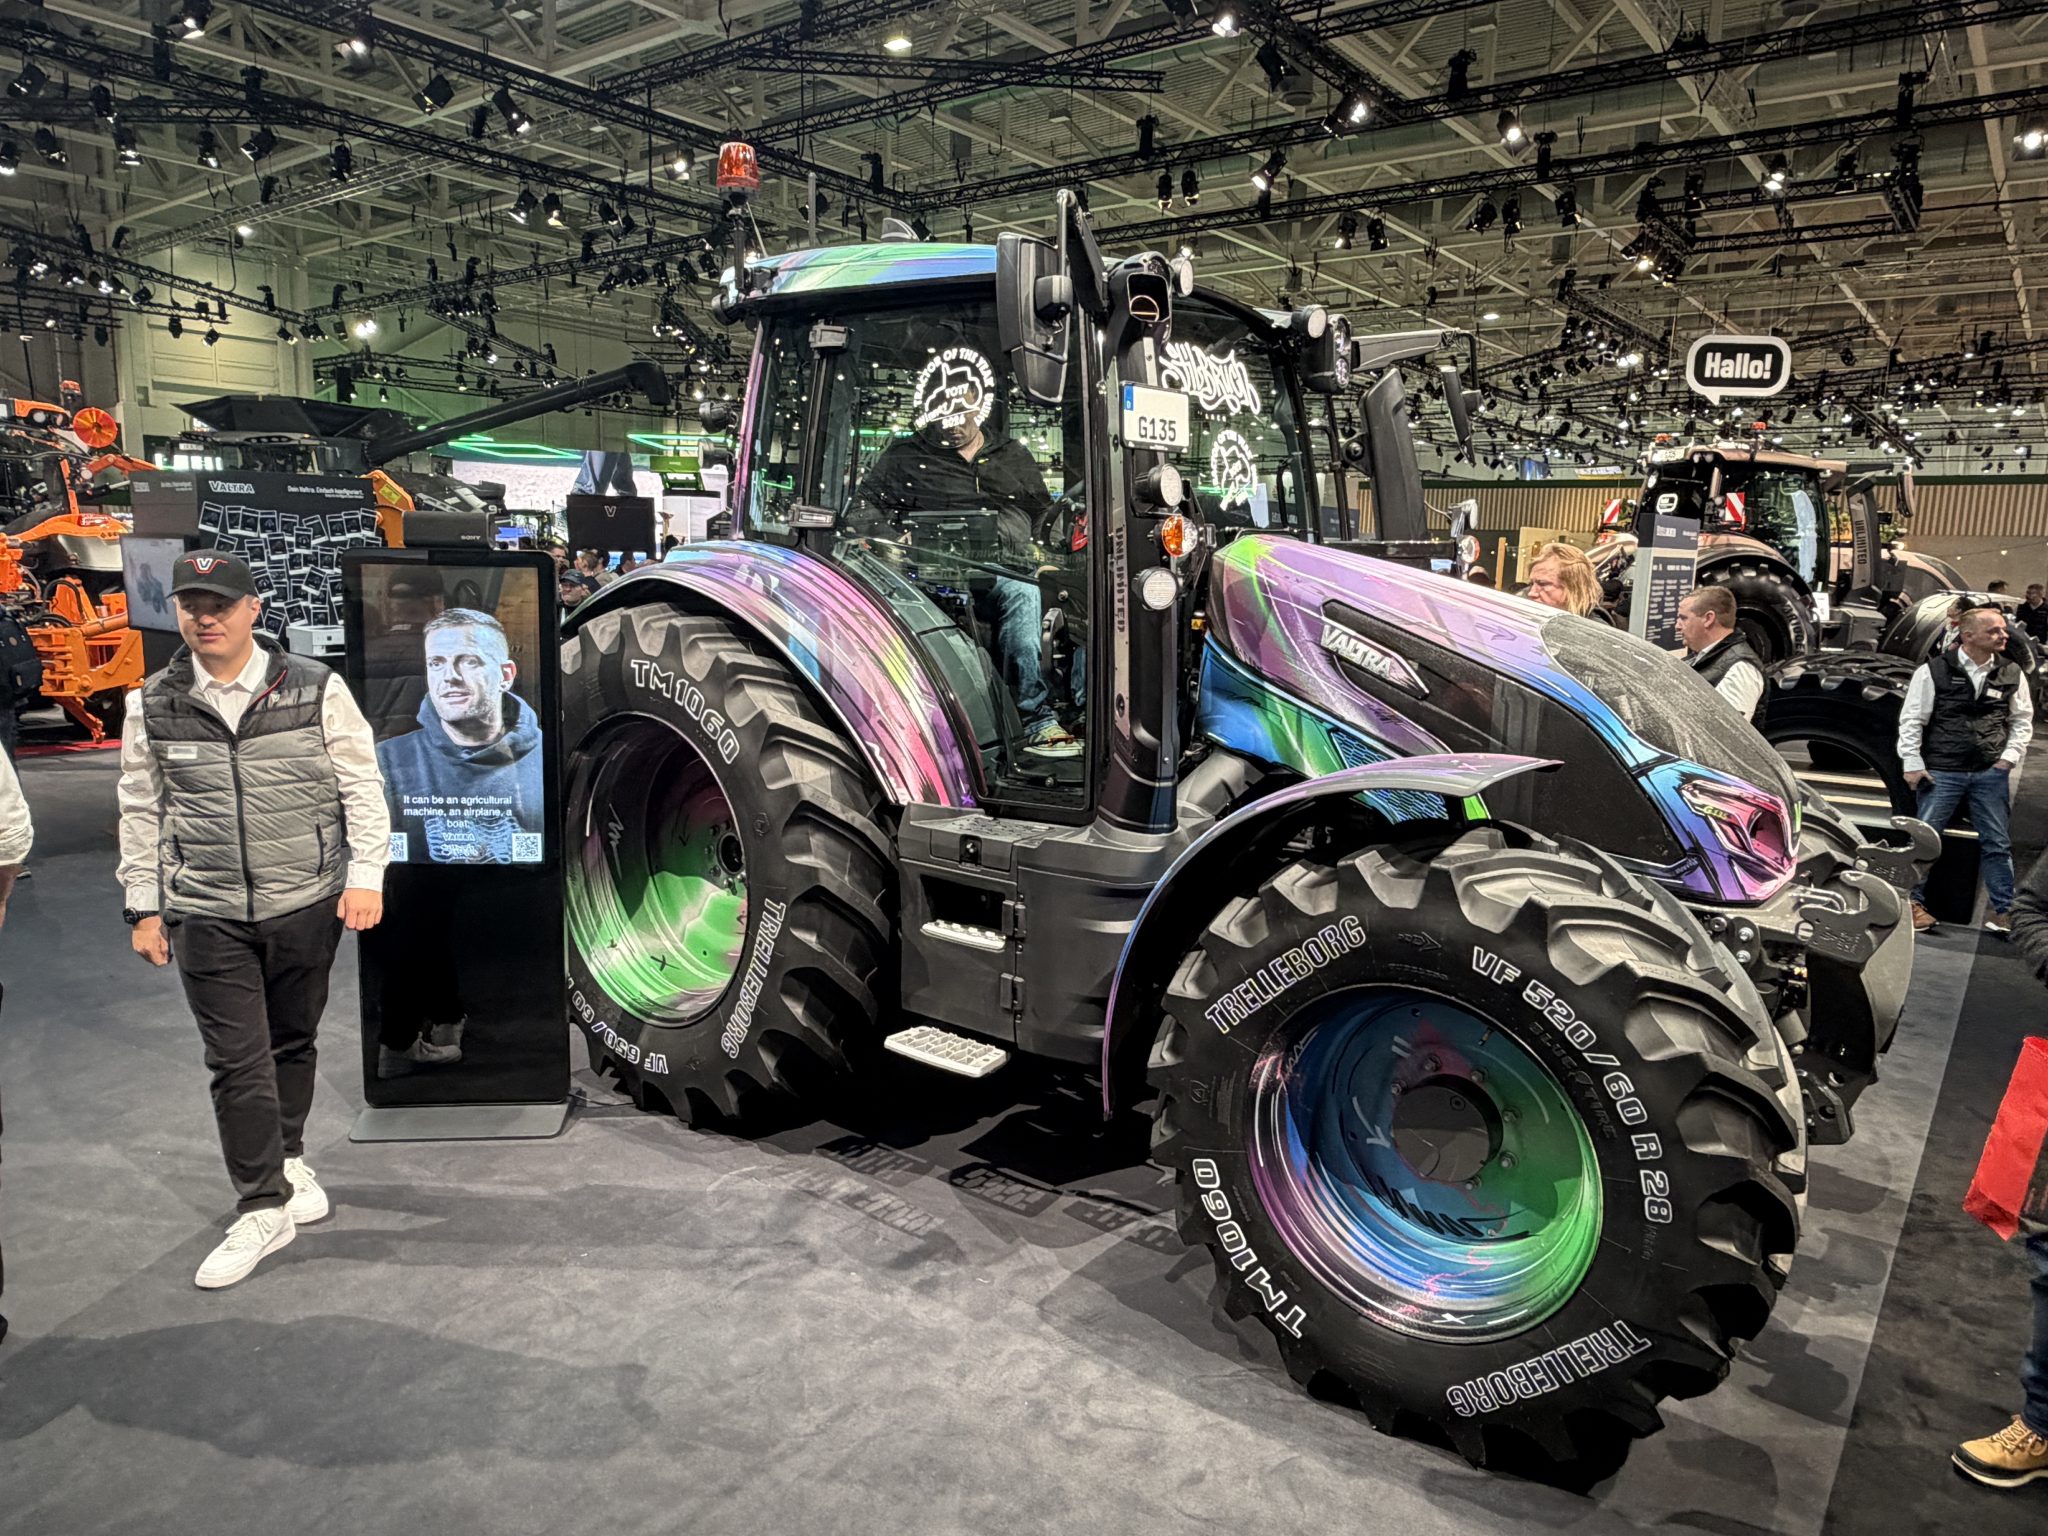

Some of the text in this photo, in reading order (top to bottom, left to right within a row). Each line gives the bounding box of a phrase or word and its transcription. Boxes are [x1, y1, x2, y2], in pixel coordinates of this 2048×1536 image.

[914, 348, 995, 408] TRACTOR OF THE YEAR
[945, 383, 970, 398] TOTY
[1704, 352, 1773, 379] Hallo!
[1138, 416, 1177, 442] G135
[208, 480, 255, 494] VALTRA
[1321, 624, 1391, 678] VALTRA
[631, 659, 740, 764] TM1060
[403, 795, 410, 804] It
[412, 796, 429, 804] can
[432, 795, 444, 804] be
[461, 795, 512, 806] agricultural
[403, 807, 447, 817] machine,
[463, 807, 505, 817] airplane,
[721, 898, 785, 1059] TRELLEBORG
[1204, 915, 1366, 1035] TRELLEBORG
[1472, 946, 1521, 986] VF
[572, 991, 669, 1074] VF 650/60
[1522, 979, 1647, 1126] 520/60
[1631, 1133, 1663, 1161] R
[1640, 1169, 1673, 1224] 28
[1192, 1158, 1307, 1339] TM1060
[1446, 1319, 1653, 1418] TRELLEBORG
